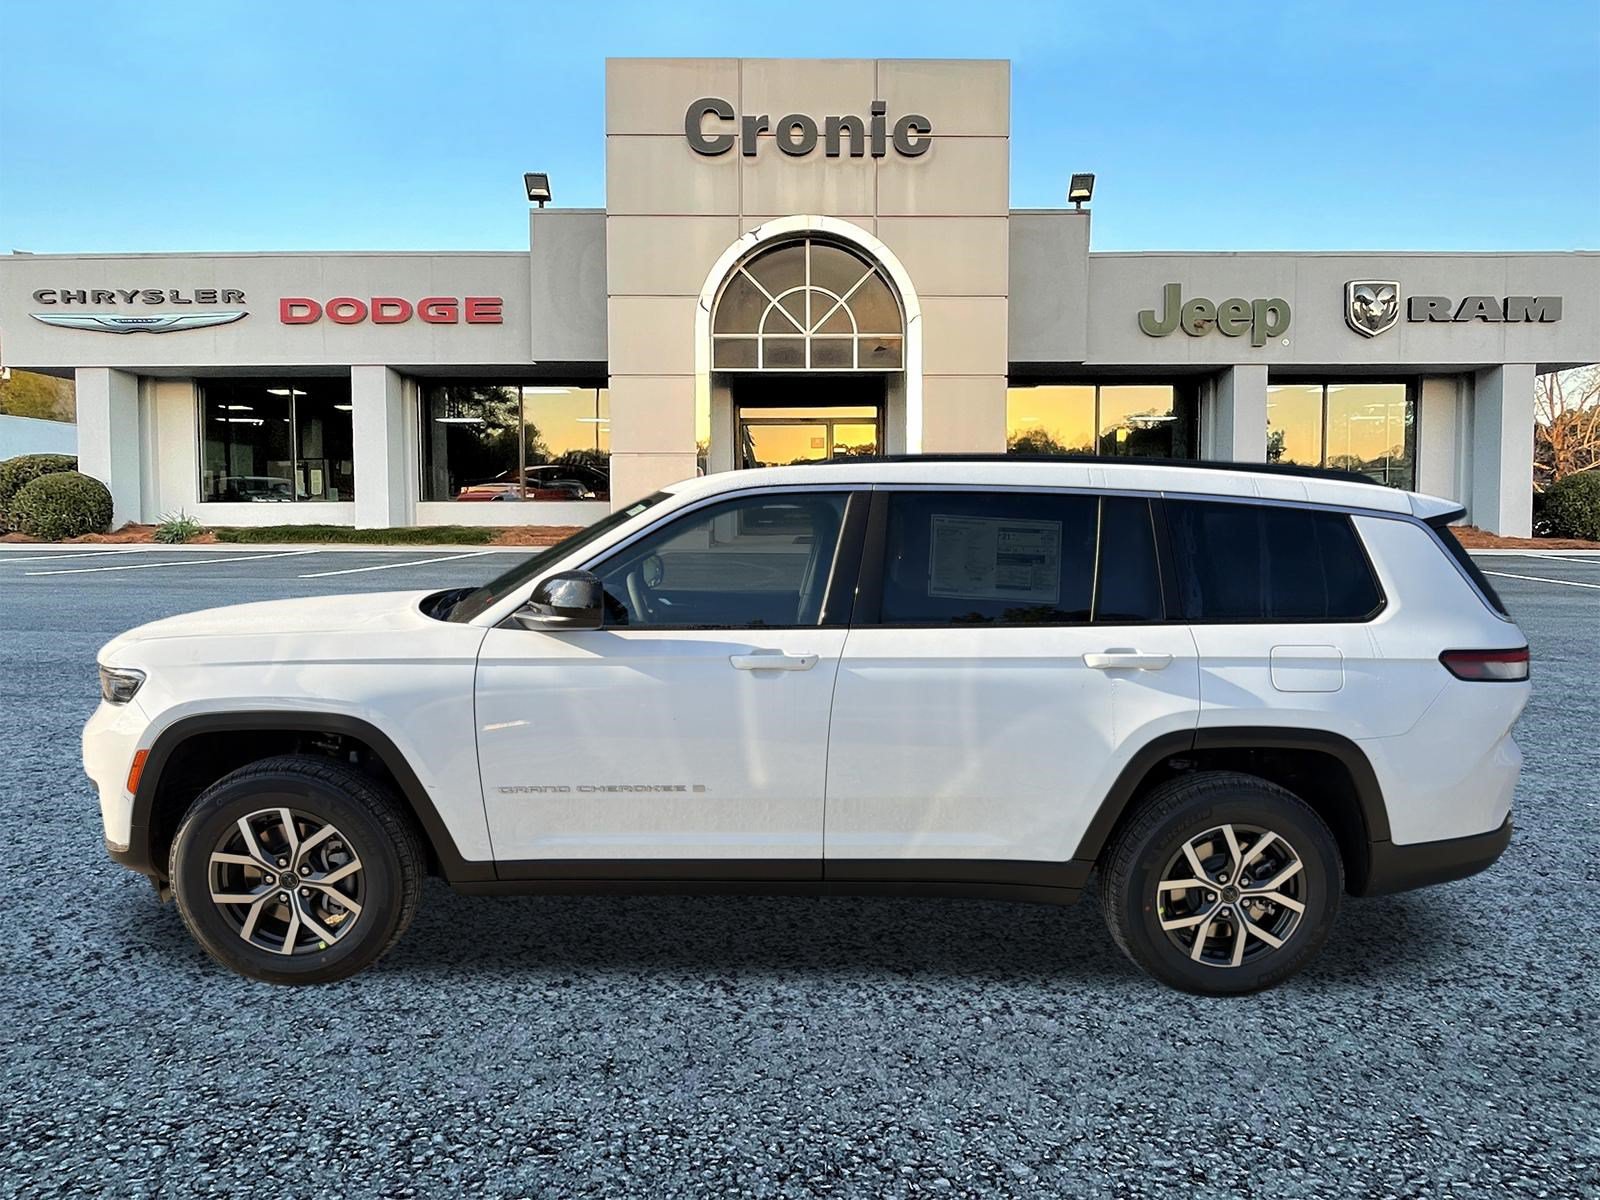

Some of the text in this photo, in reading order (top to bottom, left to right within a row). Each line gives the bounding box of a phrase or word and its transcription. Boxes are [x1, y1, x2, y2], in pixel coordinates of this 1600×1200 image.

[685, 97, 931, 157] Cronic
[32, 289, 246, 304] CHRYSLER
[1407, 296, 1563, 322] RAM
[280, 297, 503, 324] DODGE
[1138, 283, 1291, 347] Jeep
[498, 785, 571, 794] GRAND
[576, 784, 688, 793] CHEROKEE
